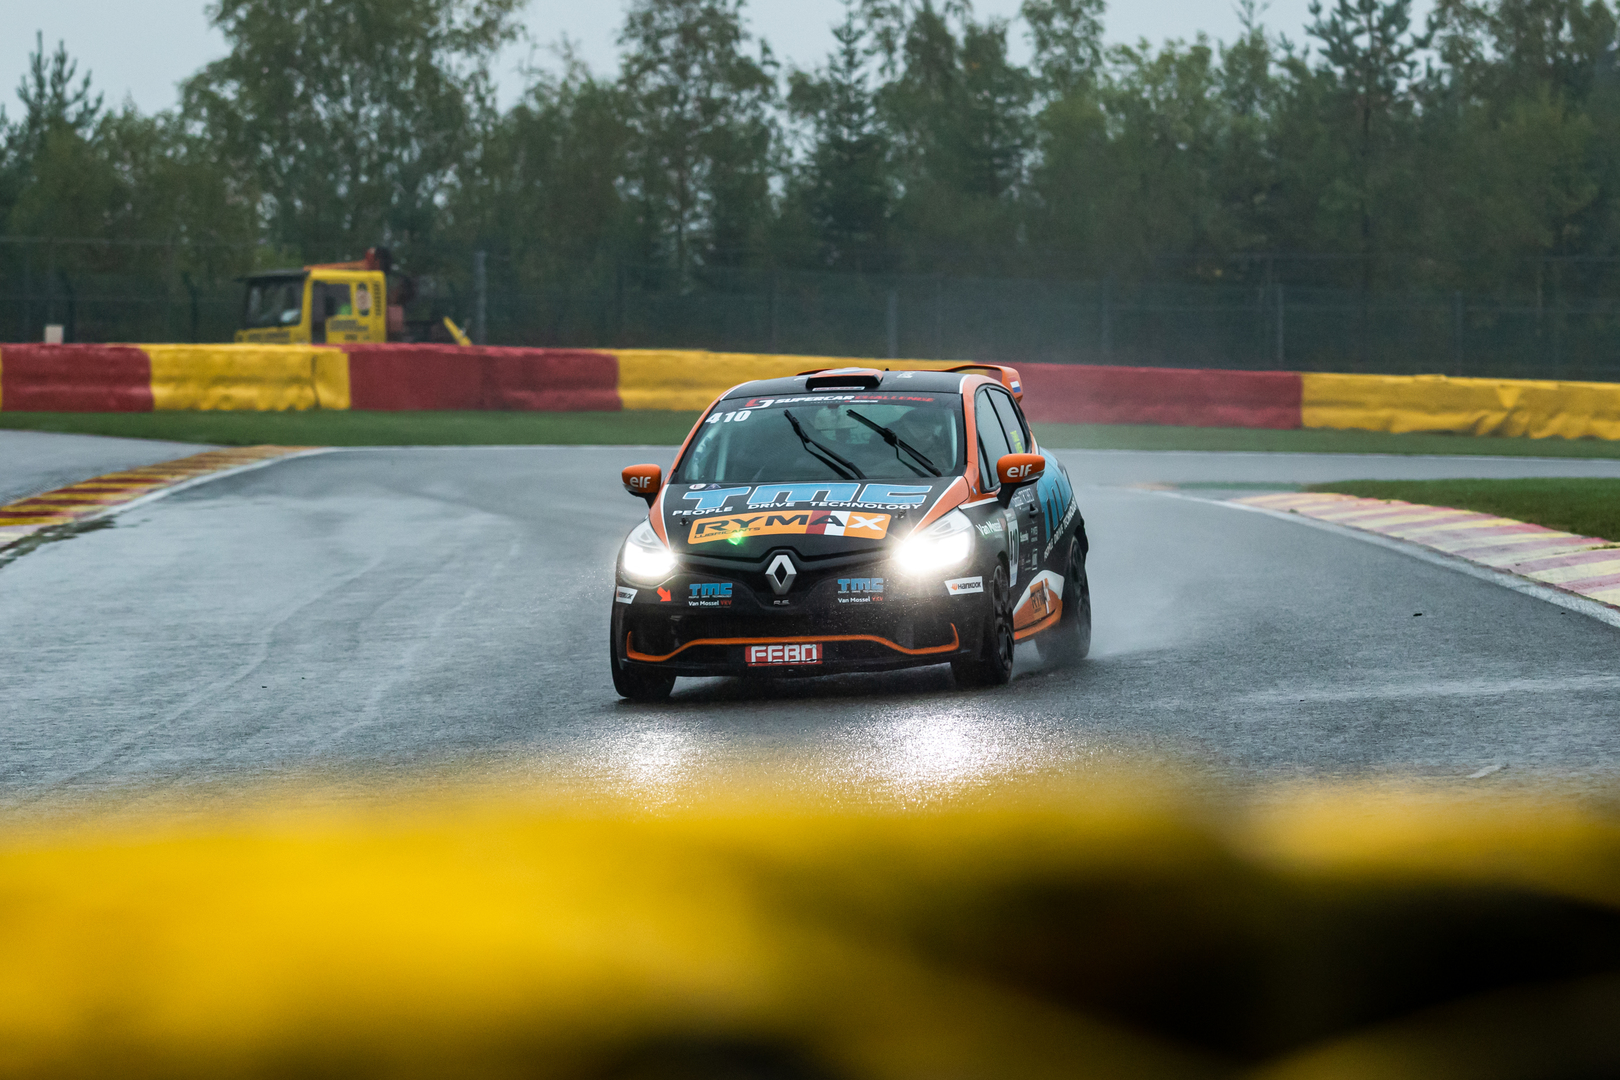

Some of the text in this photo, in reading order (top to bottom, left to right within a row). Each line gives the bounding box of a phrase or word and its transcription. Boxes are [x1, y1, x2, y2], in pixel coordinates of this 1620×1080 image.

[774, 395, 855, 404] SUPERCAR
[705, 410, 752, 424] 410
[1006, 463, 1033, 478] elf
[630, 475, 652, 488] elf
[682, 482, 933, 511] TMC
[672, 501, 923, 516] PEOPLE DRIVE TECHNOLOGY
[696, 513, 884, 535] RYMAX
[693, 526, 761, 539] LUBRICANTS
[688, 582, 733, 597] TMC
[837, 577, 884, 591] TMC
[849, 595, 871, 603] Mossel
[750, 643, 817, 665] FEBO
